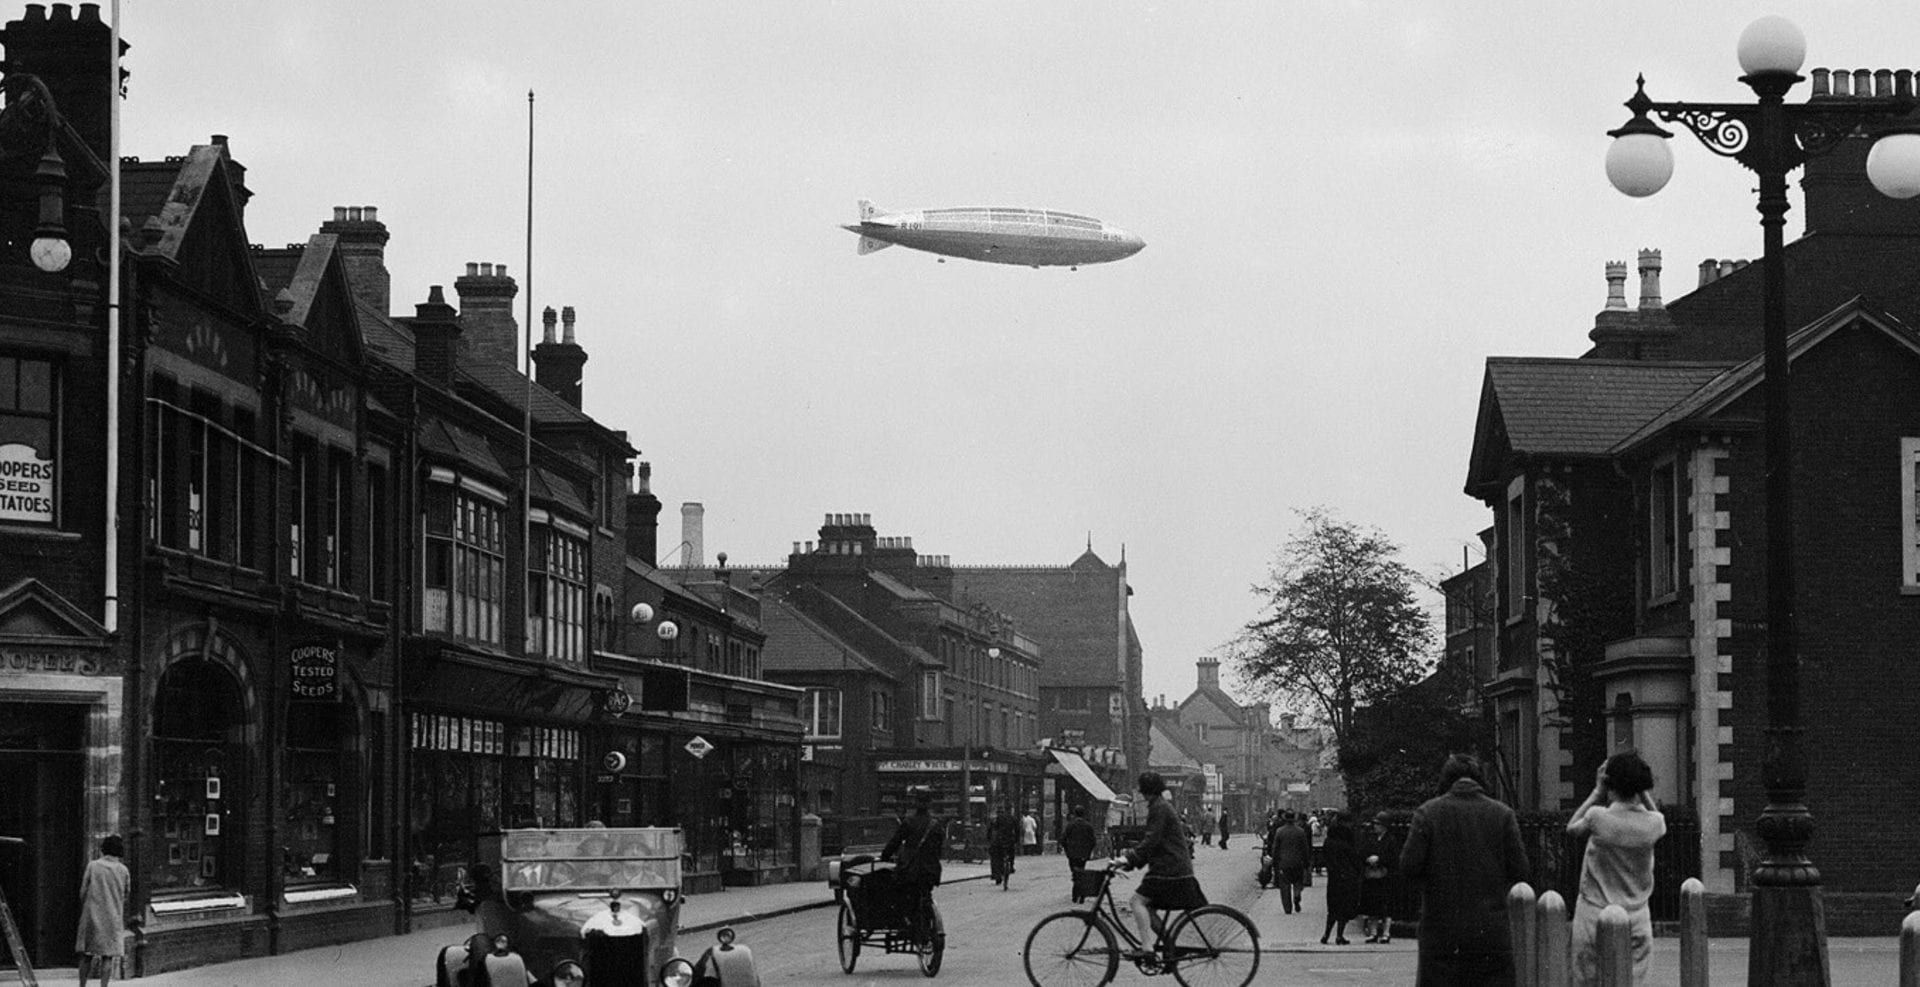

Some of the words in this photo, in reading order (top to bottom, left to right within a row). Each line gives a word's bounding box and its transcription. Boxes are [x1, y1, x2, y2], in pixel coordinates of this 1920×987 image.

[0, 460, 53, 480] OPERS'
[292, 665, 334, 677] TESTED
[293, 680, 334, 697] SEEDS
